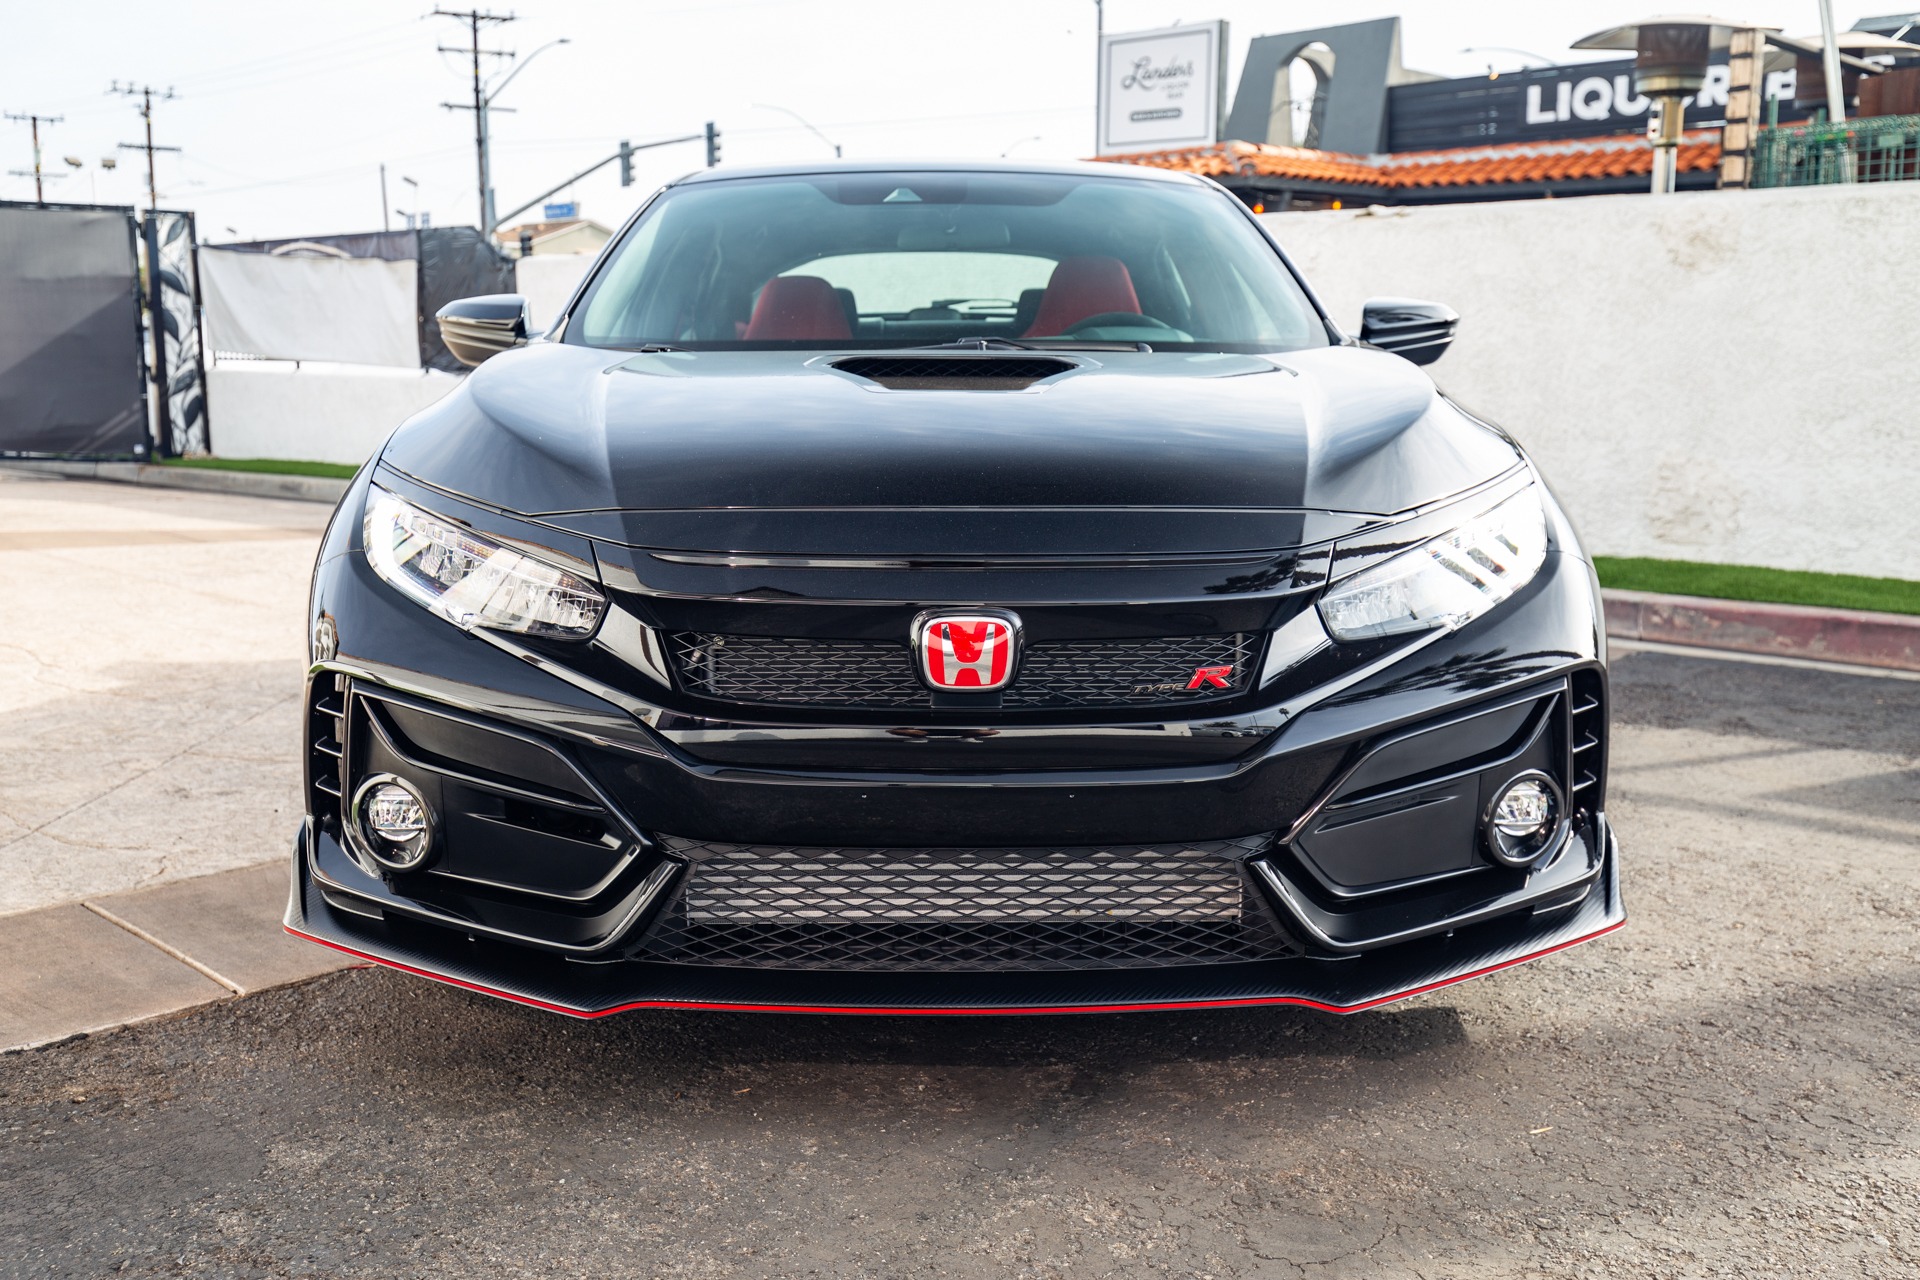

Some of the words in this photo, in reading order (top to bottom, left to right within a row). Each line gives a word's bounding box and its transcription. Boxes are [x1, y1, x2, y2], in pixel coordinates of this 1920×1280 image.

[1526, 65, 1731, 124] LIQUR
[1132, 683, 1186, 694] TYPE
[1185, 665, 1234, 689] R
